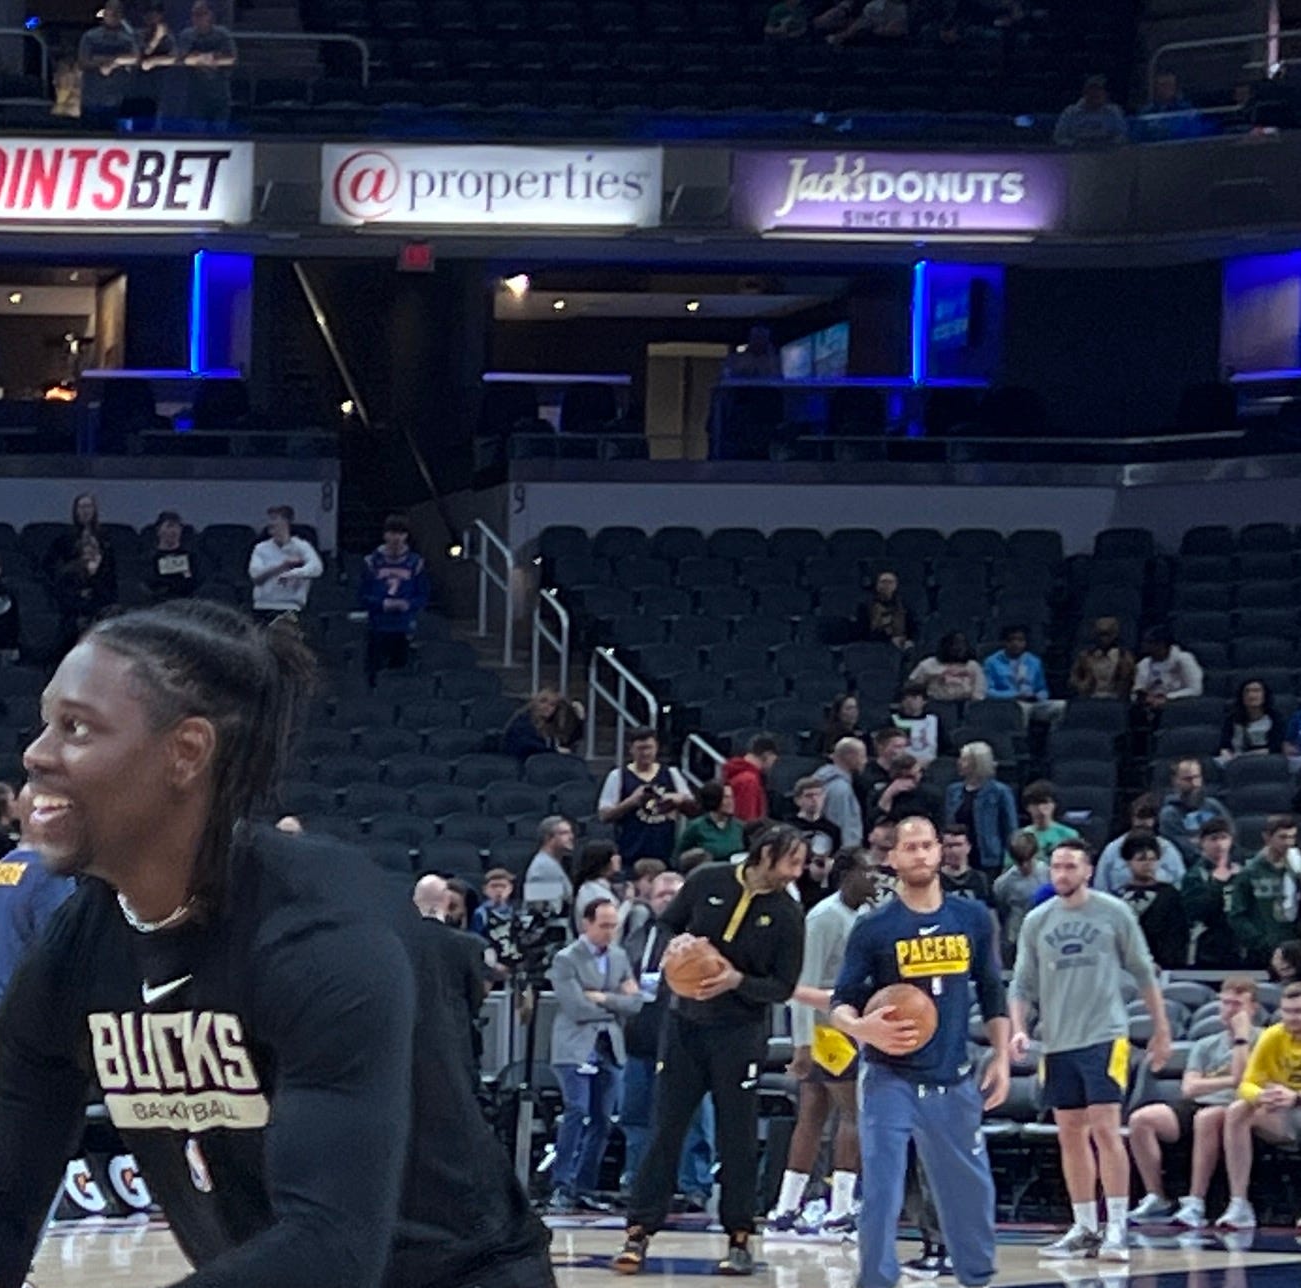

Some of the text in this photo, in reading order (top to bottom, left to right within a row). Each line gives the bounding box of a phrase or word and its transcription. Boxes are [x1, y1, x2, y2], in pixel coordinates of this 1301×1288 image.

[867, 170, 1026, 204] DONUTS
[911, 210, 961, 228] 1961
[895, 933, 971, 966] PACERS
[87, 1009, 261, 1090] BUCKS
